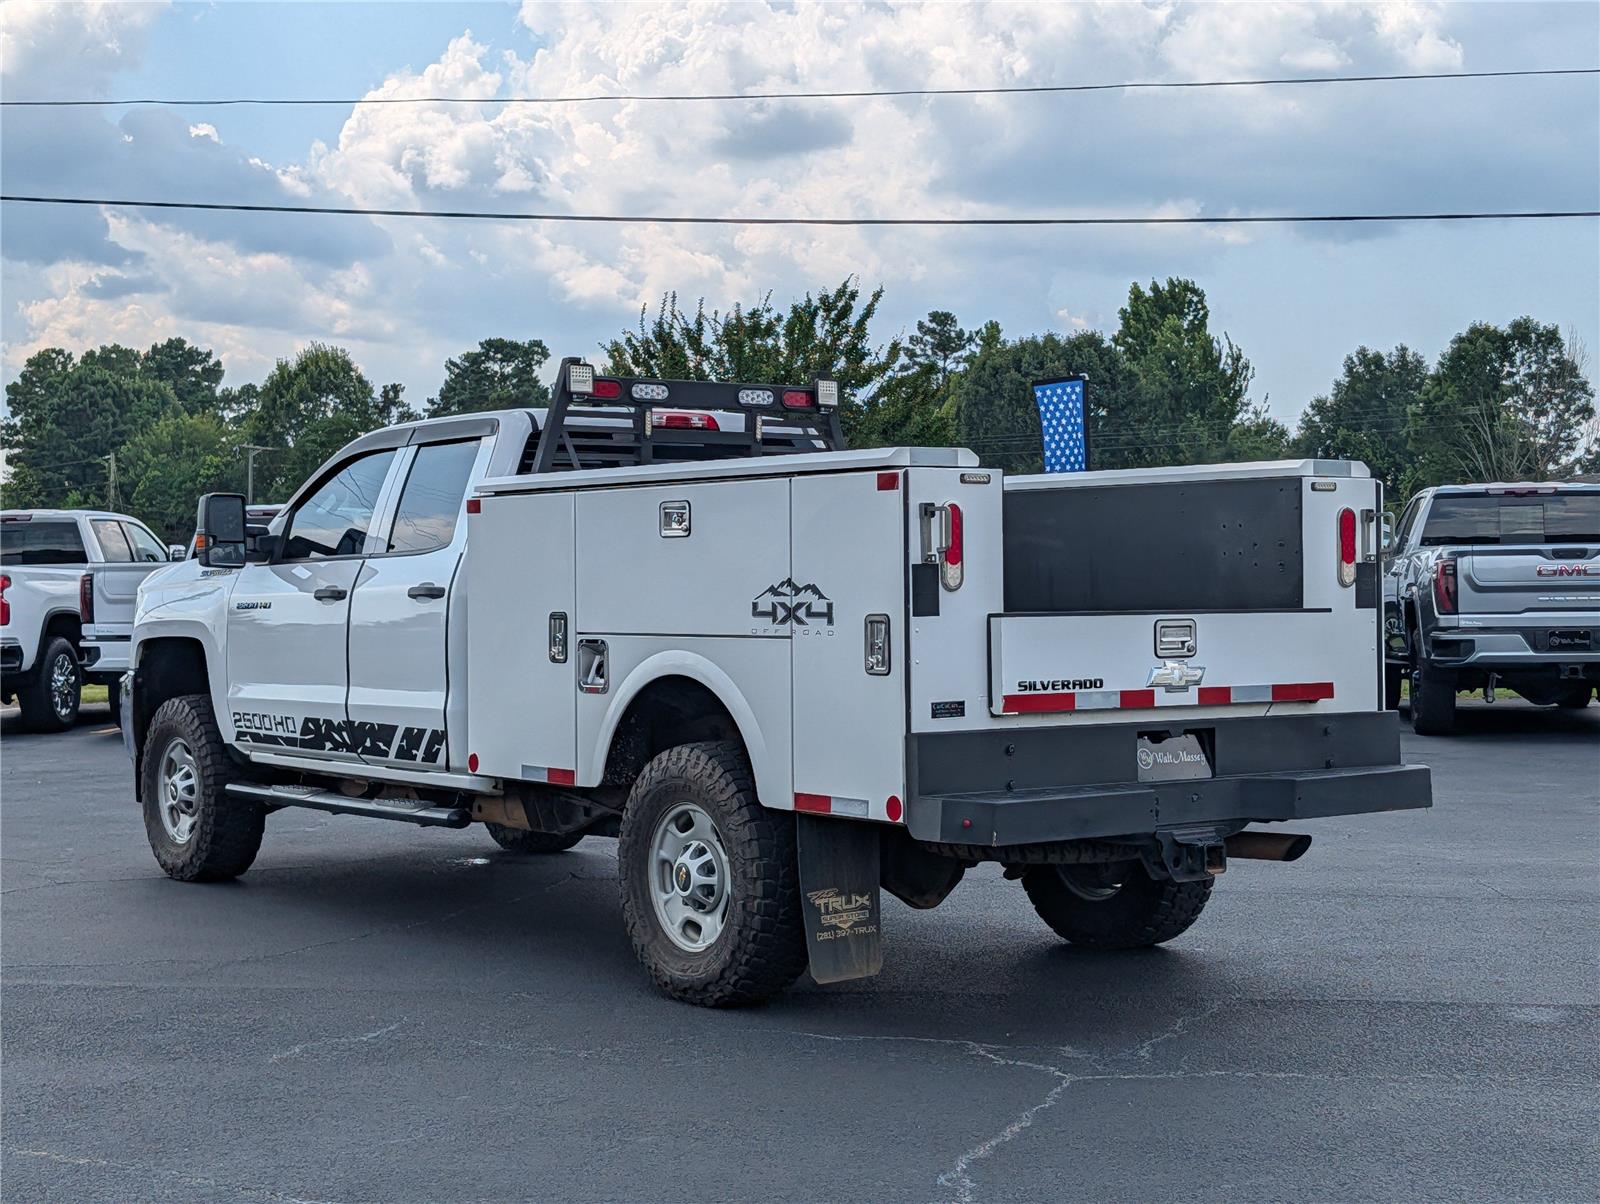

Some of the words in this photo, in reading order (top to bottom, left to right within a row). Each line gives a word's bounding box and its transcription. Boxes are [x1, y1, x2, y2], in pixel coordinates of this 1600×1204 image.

[1536, 564, 1600, 577] GMC
[791, 629, 835, 637] ROAD
[1017, 678, 1104, 692] SILVERADO
[1151, 751, 1173, 764] Walt
[1172, 750, 1206, 765] Massey
[818, 894, 870, 913] TRUX
[816, 931, 835, 942] (281)
